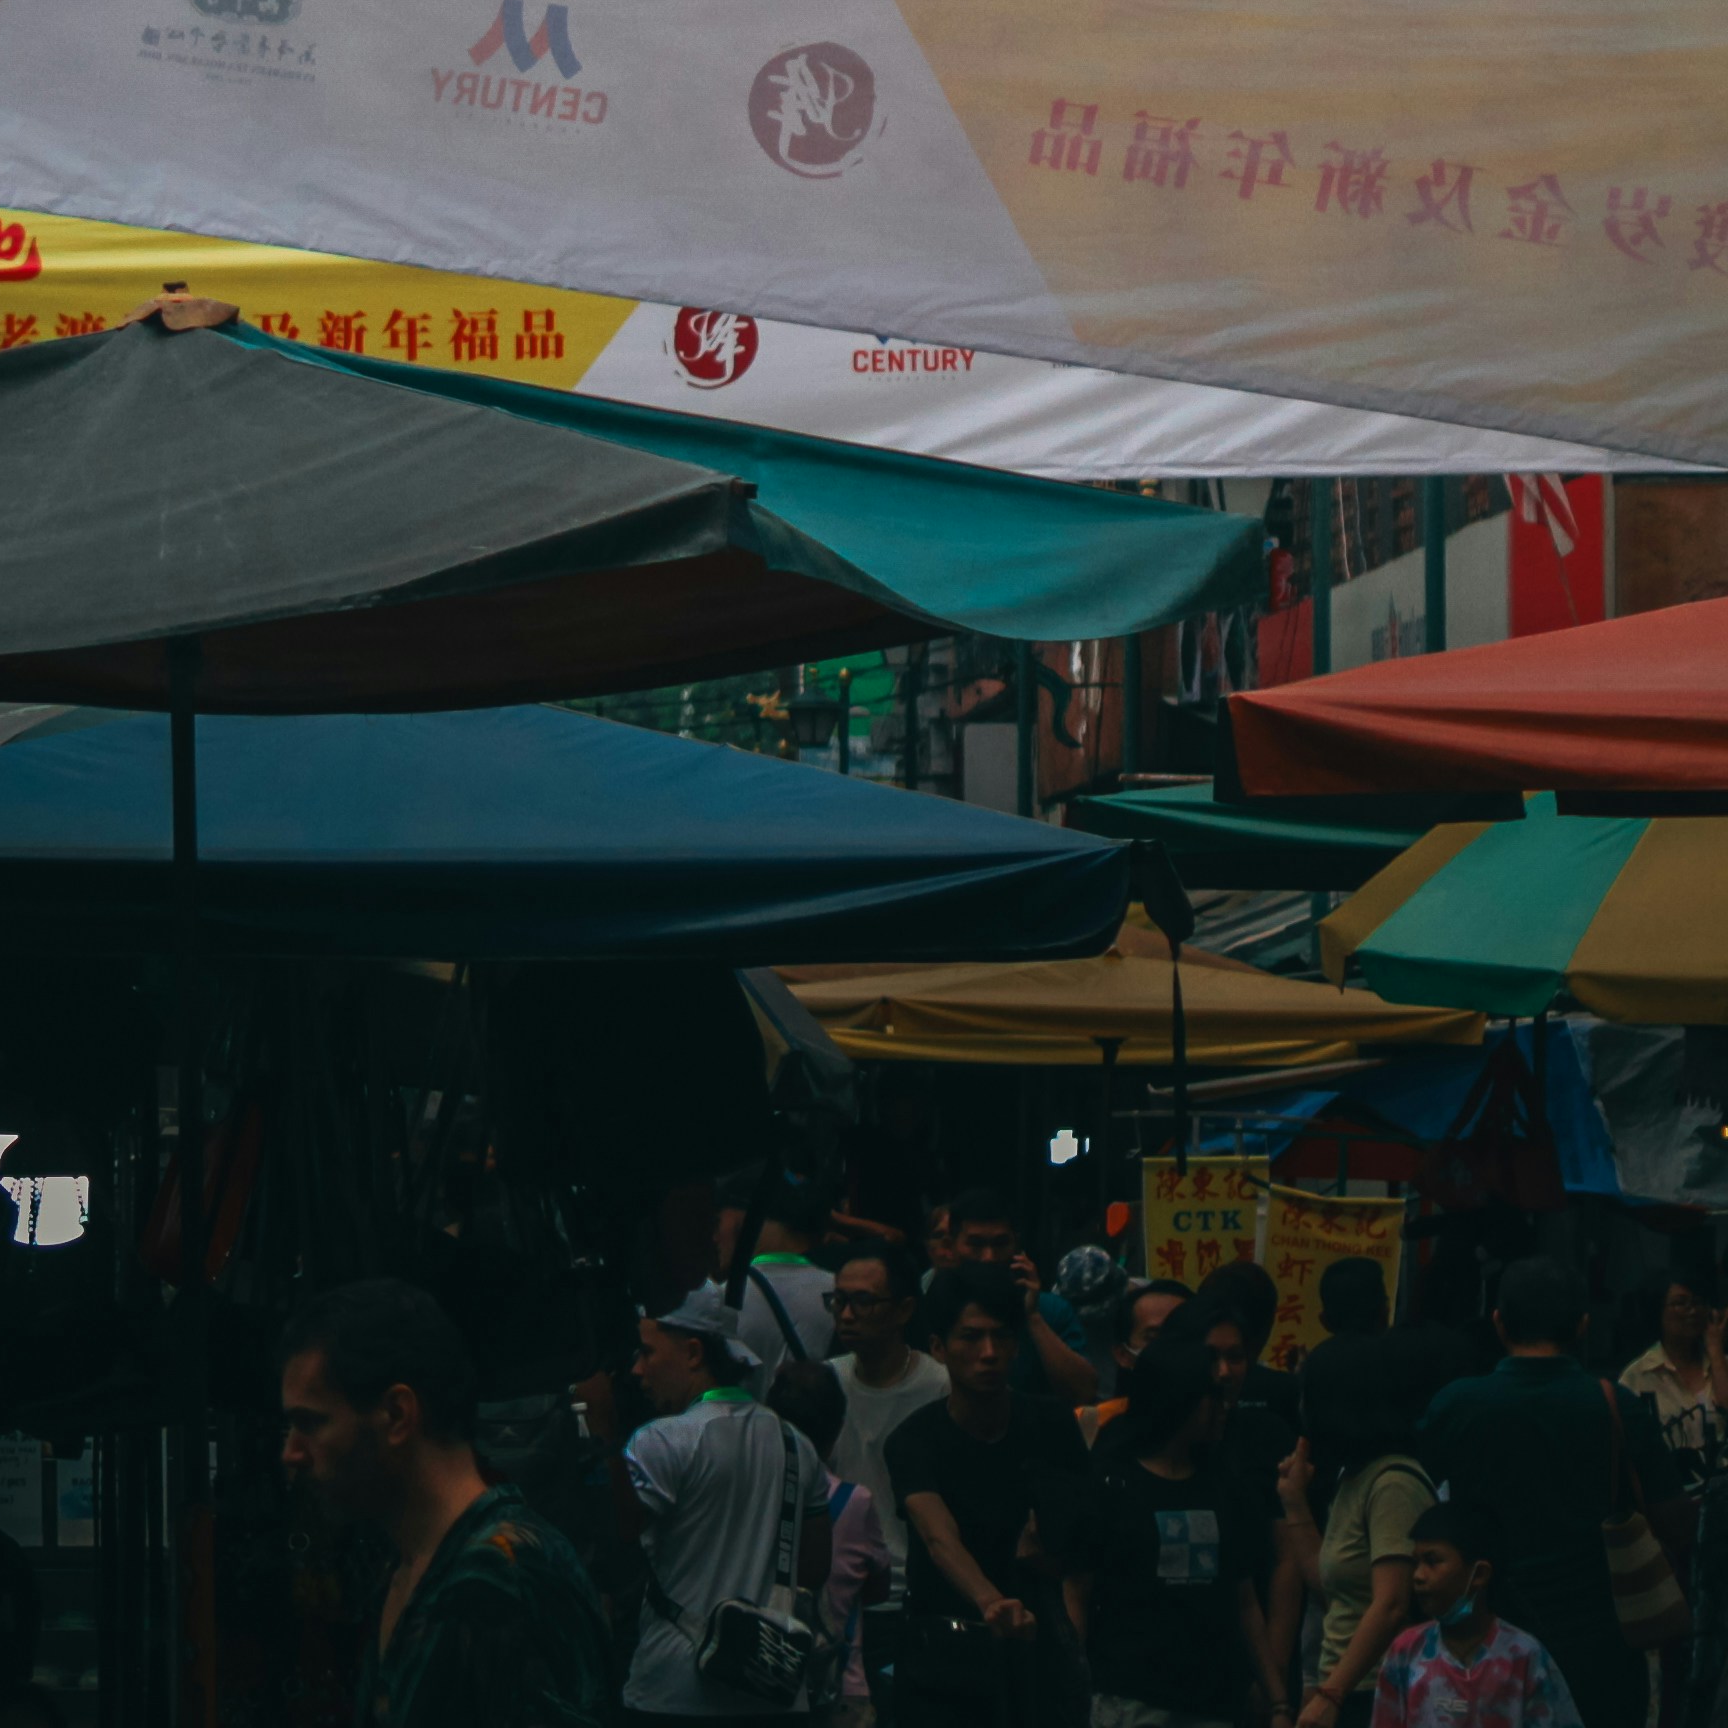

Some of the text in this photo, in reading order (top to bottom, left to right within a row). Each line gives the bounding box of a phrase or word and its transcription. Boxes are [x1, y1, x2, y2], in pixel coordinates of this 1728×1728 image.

[852, 348, 976, 374] CENTURY
[1173, 1210, 1242, 1233] CTK
[1271, 1234, 1310, 1251] CHAN
